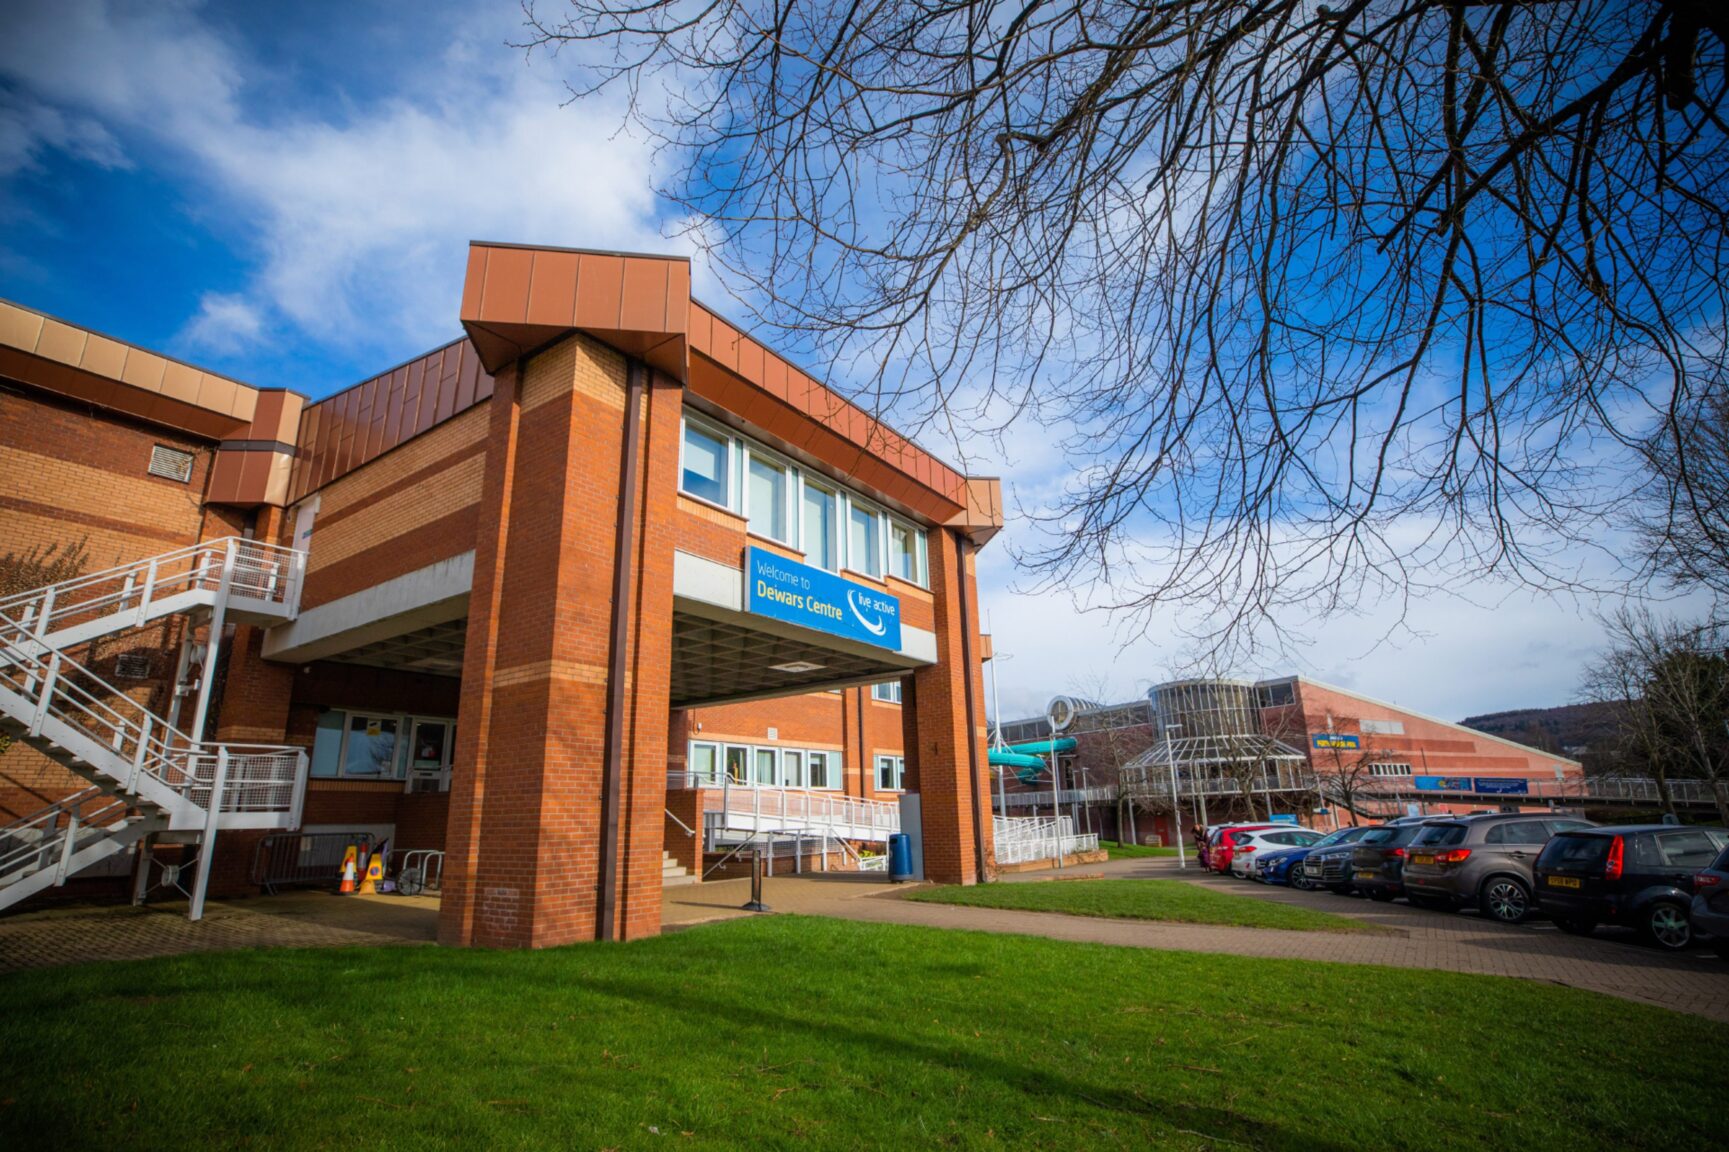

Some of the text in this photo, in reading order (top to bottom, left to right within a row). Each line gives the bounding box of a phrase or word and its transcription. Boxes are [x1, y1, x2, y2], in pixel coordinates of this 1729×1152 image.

[757, 560, 811, 590] Welcome to
[757, 579, 843, 620] Dewars Centre
[858, 592, 895, 616] live active
